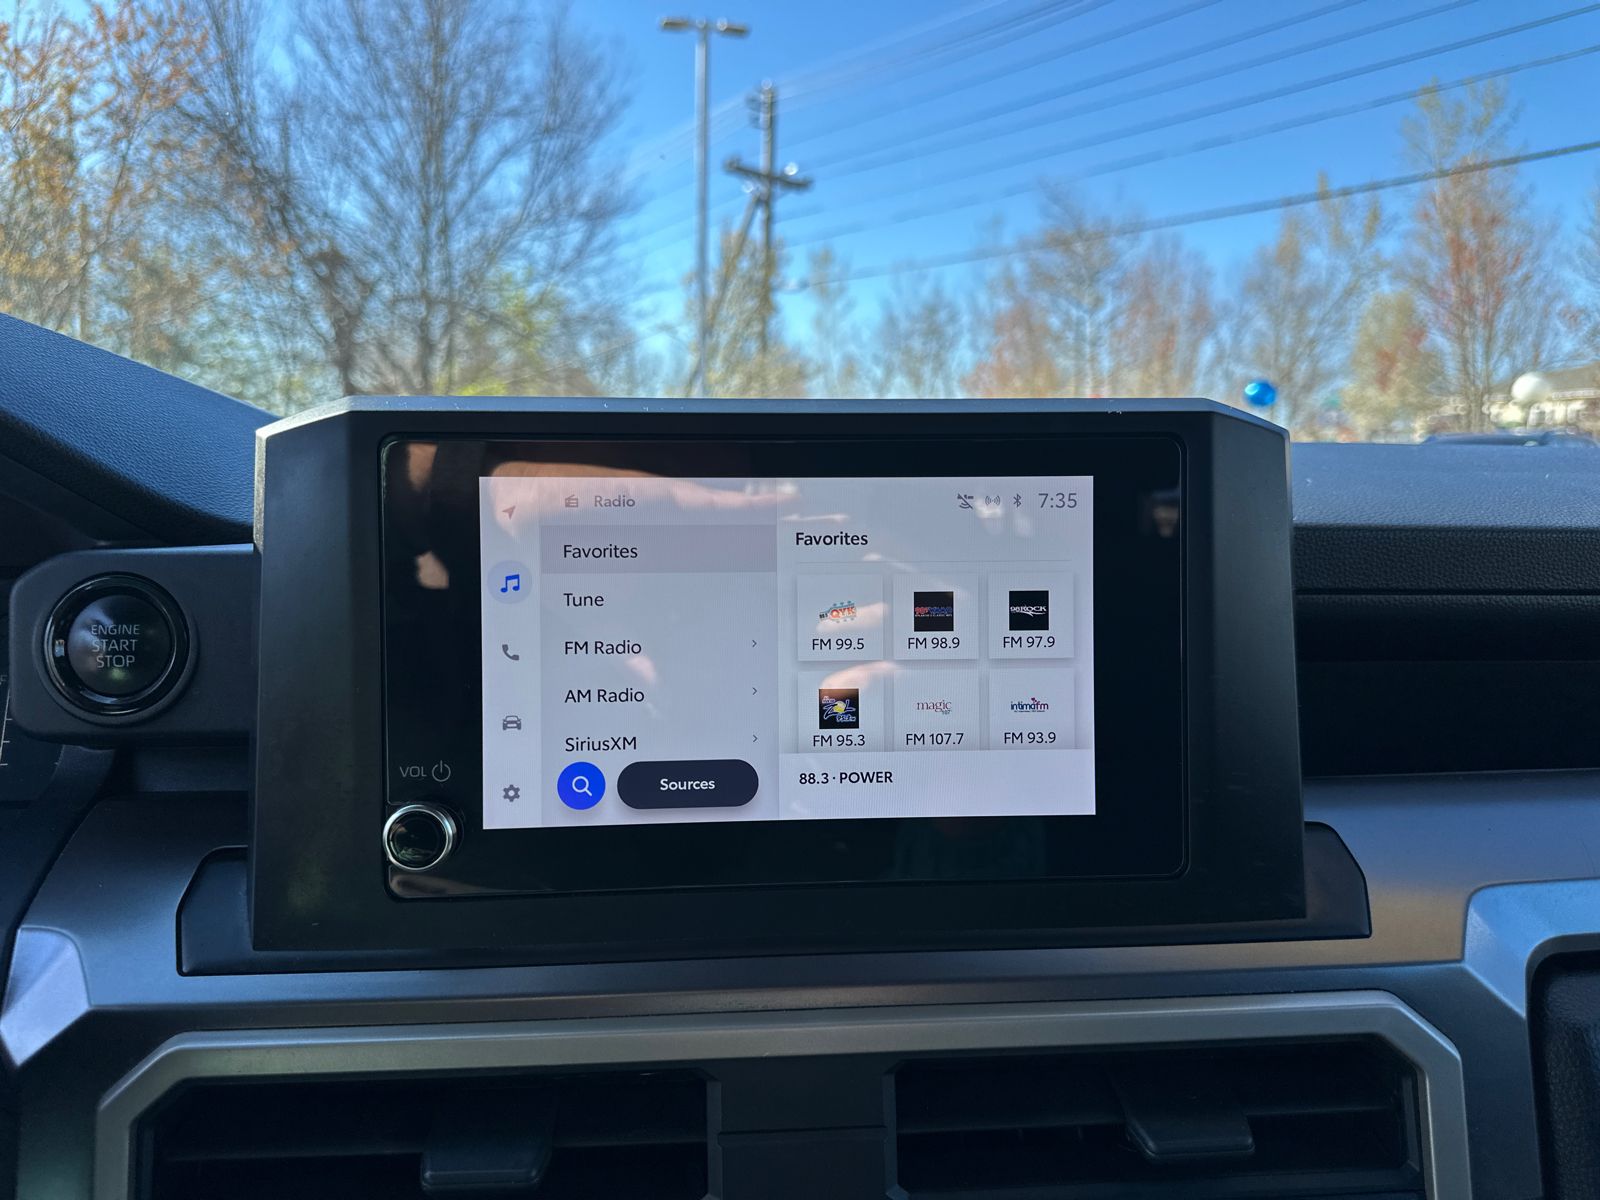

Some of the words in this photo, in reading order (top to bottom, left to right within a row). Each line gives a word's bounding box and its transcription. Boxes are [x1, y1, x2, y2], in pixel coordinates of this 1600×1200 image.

[594, 495, 636, 508] Radio
[1038, 493, 1078, 509] 7:35
[795, 531, 868, 546] Favorites
[563, 544, 638, 559] Favorites
[563, 593, 605, 607] Tune
[91, 624, 140, 635] ENGINE
[92, 639, 138, 652] START
[564, 641, 589, 655] FM
[594, 639, 642, 654] Radio
[812, 639, 832, 650] FM
[835, 638, 865, 650] 99.5
[908, 638, 927, 649] FM
[931, 637, 960, 649] 98.9
[1003, 637, 1023, 648] FM
[1026, 636, 1055, 648] 97.9
[96, 655, 135, 668] STOP
[564, 689, 592, 703] AM
[597, 688, 645, 703] Radio
[917, 699, 952, 712] magic
[565, 736, 637, 752] SiriusXM
[813, 735, 832, 747] FM
[836, 734, 866, 746] 95.3
[906, 734, 925, 745] FM
[929, 733, 964, 745] 107.7
[1004, 732, 1023, 744] FM
[1027, 731, 1056, 744] 93.9
[400, 766, 427, 778] VOL
[799, 772, 829, 785] 88.3
[839, 771, 893, 784] POWER
[660, 777, 716, 791] Sources
